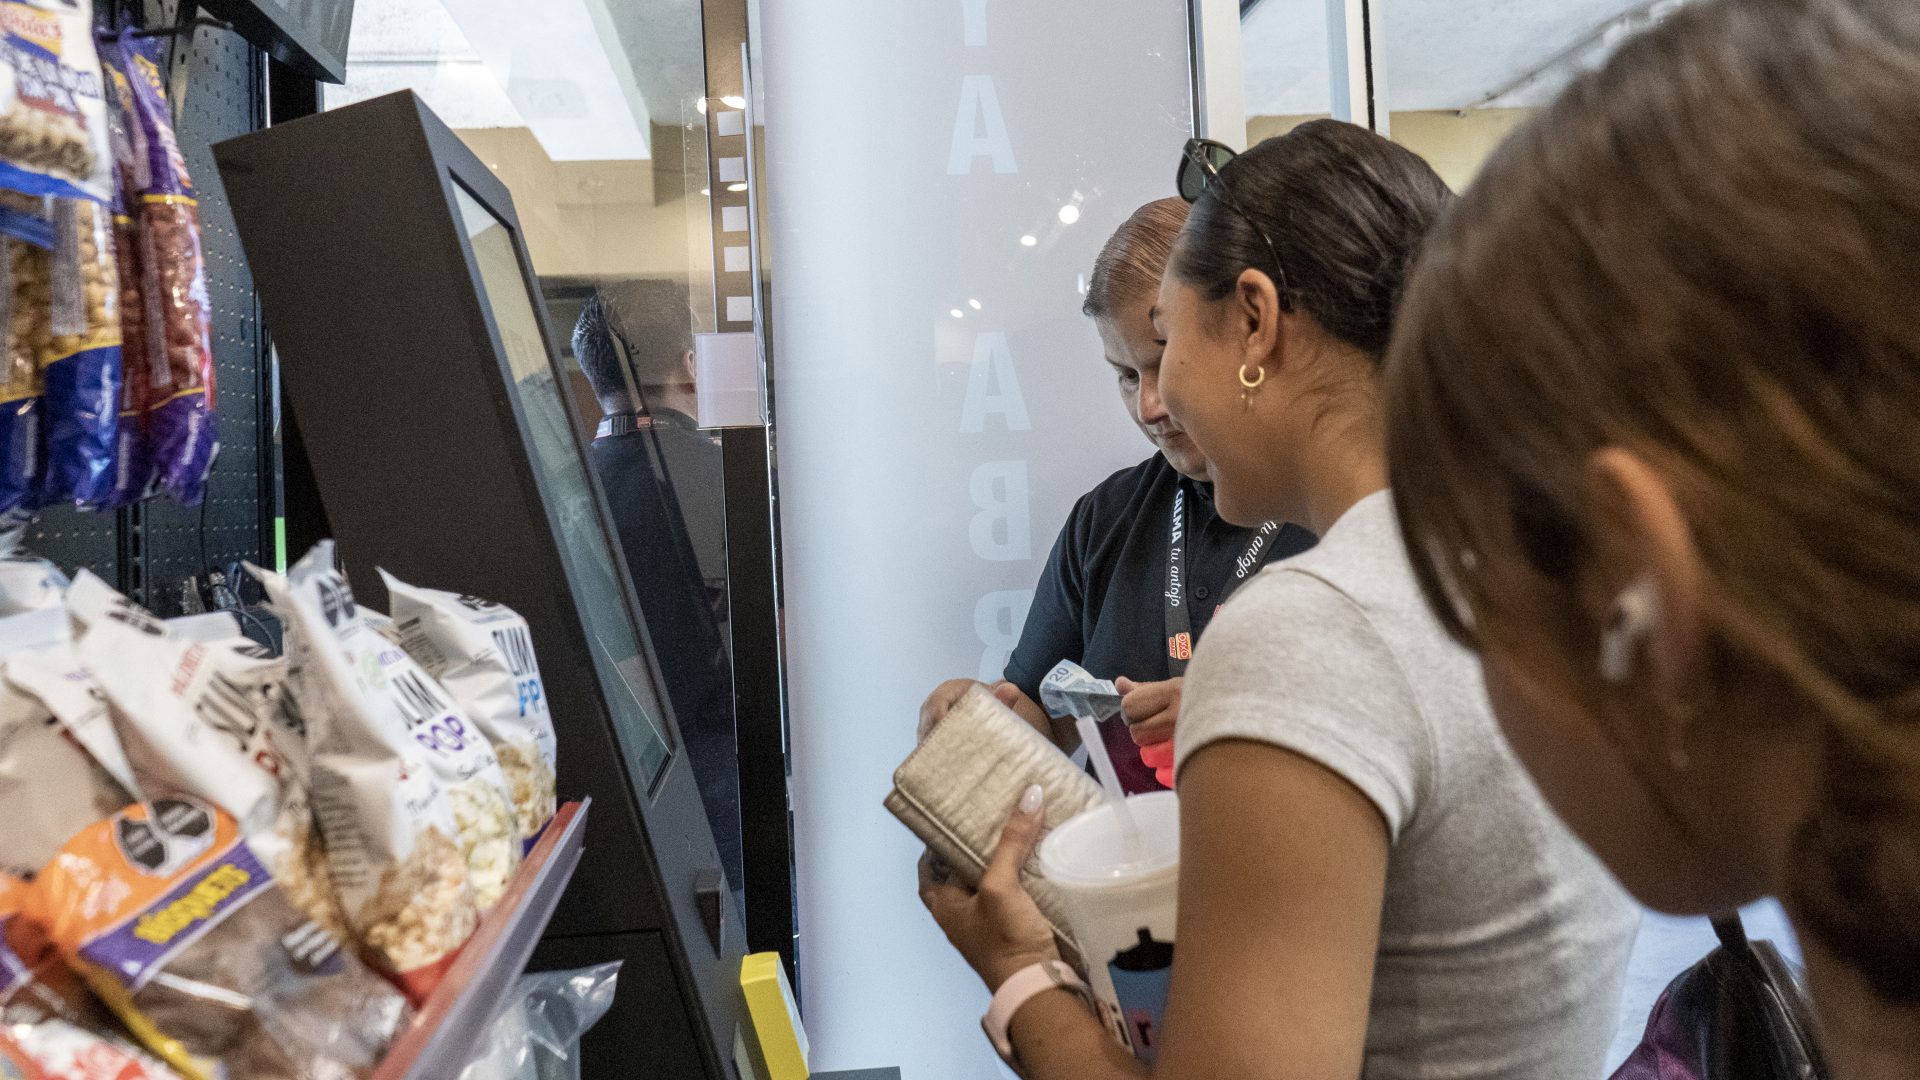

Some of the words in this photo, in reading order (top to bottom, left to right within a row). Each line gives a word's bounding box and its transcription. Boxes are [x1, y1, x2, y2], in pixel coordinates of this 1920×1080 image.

[1171, 488, 1185, 544] CALMA
[1260, 520, 1278, 535] tu
[1171, 548, 1182, 563] tu
[1236, 535, 1264, 579] antojo
[1164, 565, 1182, 607] antojo
[1177, 633, 1189, 659] OXXO
[1050, 667, 1069, 682] 20
